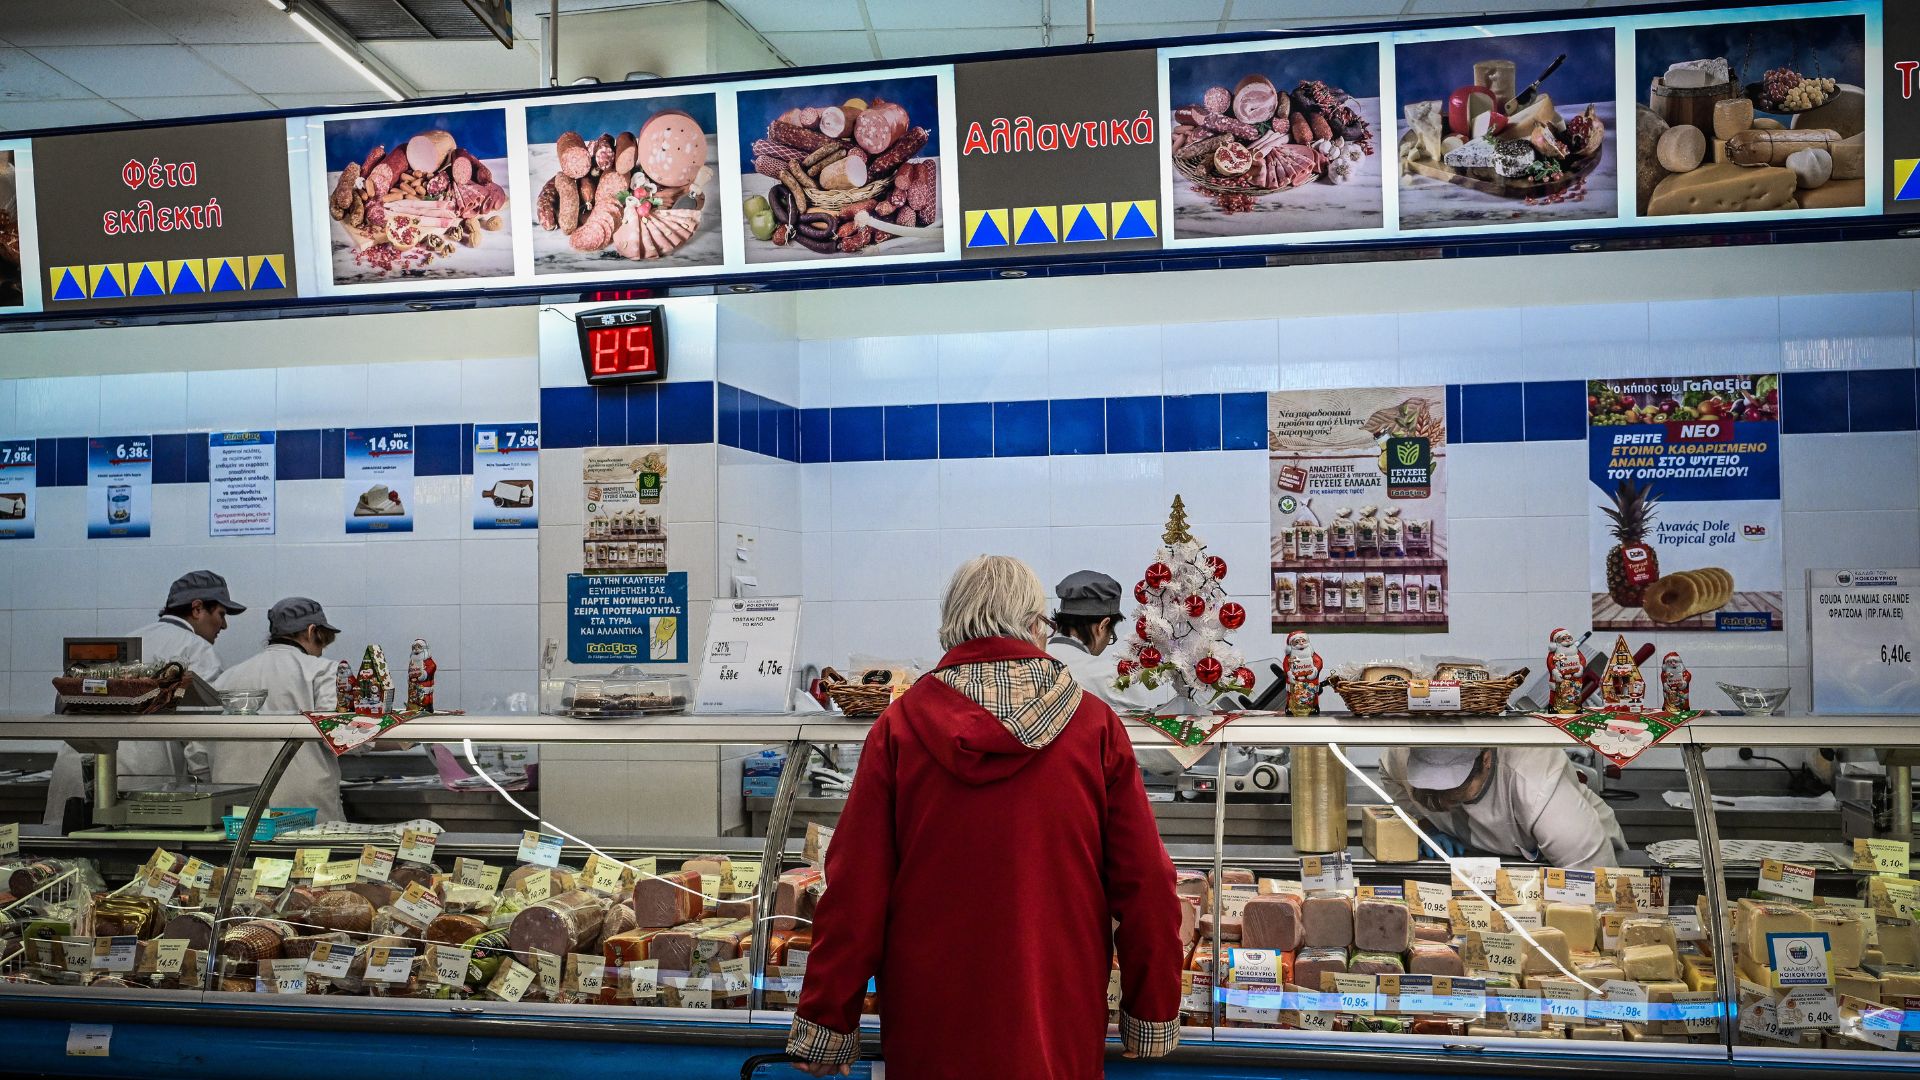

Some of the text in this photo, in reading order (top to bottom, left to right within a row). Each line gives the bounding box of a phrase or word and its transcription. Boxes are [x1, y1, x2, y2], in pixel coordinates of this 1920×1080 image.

[1893, 60, 1920, 100] Τ
[962, 109, 1155, 156] Αλλαντικά
[122, 157, 197, 192] Φέτα
[102, 196, 223, 236] εκλεκτή
[619, 313, 637, 322] ICS
[595, 326, 650, 373] 85
[1623, 383, 1658, 395] κήπος
[1660, 383, 1680, 393] του
[1682, 378, 1752, 394] Γαλαξία
[1315, 419, 1333, 429] από
[1679, 424, 1720, 439] ΝΕΟ
[369, 436, 411, 454] 14,90€
[1613, 433, 1662, 445] ΒΡΕΙΤΕ
[116, 443, 149, 459] 6,38€
[1610, 442, 1768, 456] ΕΤΟΙΜΟ ΚΑΘΑΡΙΣΜΕΝΟ
[2, 448, 33, 464] 7,98€
[1608, 454, 1741, 468] ΑΝΑΝΑ ΣΤΟ ΨΥΓΕΙΟ
[1309, 465, 1355, 473] ΑΝΑΖΗΤΕΙΣΤΕ
[1390, 468, 1427, 477] ΓΕΥΣΕΙΣ
[1606, 466, 1750, 480] ΤΟΥ ΟΠΟΡΩΠΩΛΕΙΟΥ!
[1309, 479, 1343, 488] ΓΕΥΣΕΙΣ
[1344, 478, 1382, 487] ΕΛΛΑΔΑΣ
[1390, 475, 1427, 485] ΕΛΛΑΔΑΣ
[1656, 520, 1730, 533] Ανανάς Dole
[1743, 525, 1766, 534] Dole
[1656, 531, 1736, 547] Tropical gold
[588, 576, 666, 585] ΓΙΑ ΤΗΝ ΚΑΛΥΤΕΡΗ
[588, 586, 666, 595] ΕΞΥΠΗΡΕΤΗΣΗ ΣΑΣ
[580, 596, 674, 606] ΠΑΡΤΕ ΝΟΥΜΕΡΟ ΓΙΑ
[1819, 593, 1910, 604] GOUDA ΟΛΛΑΝΔΙΑΣ GRANDE
[573, 606, 682, 616] ΣΕΙΡΑ ΠΡΟΤΕΡΑΙΟΤΗΤΑΣ
[1828, 608, 1862, 618] ΦΡΑΤΖΟΛΑ
[590, 617, 632, 626] ΣΤΑ ΤΥΡΙΑ
[580, 627, 643, 636] ΚΑΙ ΑΛΛΑΝΤΙΚΑ
[586, 643, 638, 656] Γαλαξίας
[1880, 644, 1912, 665] 6,40€
[757, 660, 783, 678] 4,75€
[1880, 858, 1904, 869] 8,10€
[737, 879, 756, 890] 8,74€
[1423, 901, 1447, 913] 10,95€
[1466, 918, 1489, 930] 18,90€
[157, 958, 179, 968] 14,57€
[1488, 953, 1517, 967] 13,48€
[436, 967, 460, 979] 10,25€
[1779, 971, 1827, 979] ΝΟΙΚΟΚΥΡΙΟΥ
[278, 979, 304, 990] 13,70€
[582, 977, 599, 988] 5,58€
[636, 982, 654, 993] 5,20€
[1341, 995, 1370, 1009] 10,95€
[1550, 1004, 1580, 1016] 11,10€
[1304, 1013, 1326, 1028] 9,84€
[1506, 1011, 1537, 1024] 13,48€
[1684, 1016, 1716, 1028] 11,98€
[1806, 1011, 1834, 1024] 6,40€
